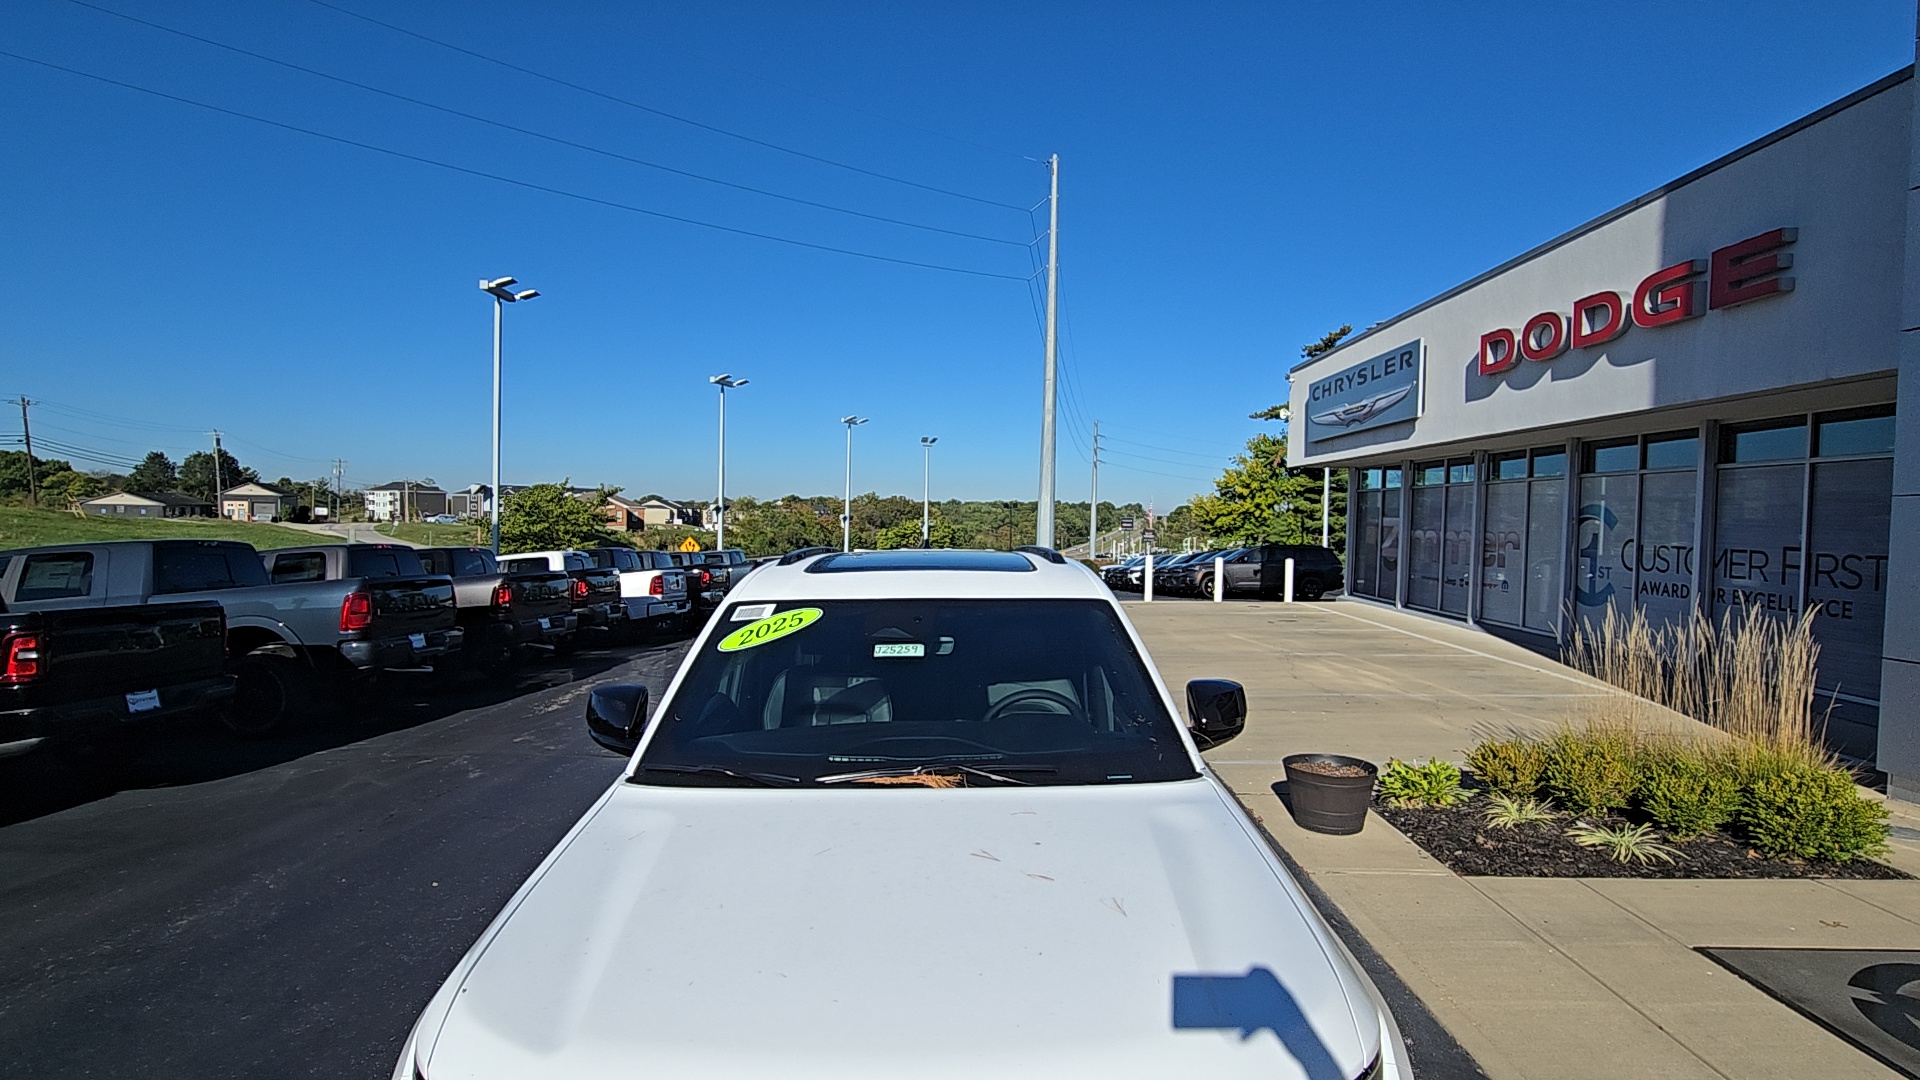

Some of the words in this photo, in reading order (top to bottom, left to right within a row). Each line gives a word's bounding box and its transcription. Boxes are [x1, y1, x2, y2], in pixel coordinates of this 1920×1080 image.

[1479, 228, 1795, 377] DODGE
[1312, 349, 1414, 402] CHRYSLER
[1640, 580, 1690, 599] AWARD
[1732, 588, 1853, 620] EXCELLNCE
[737, 611, 804, 647] 2025
[874, 645, 919, 655] J25259
